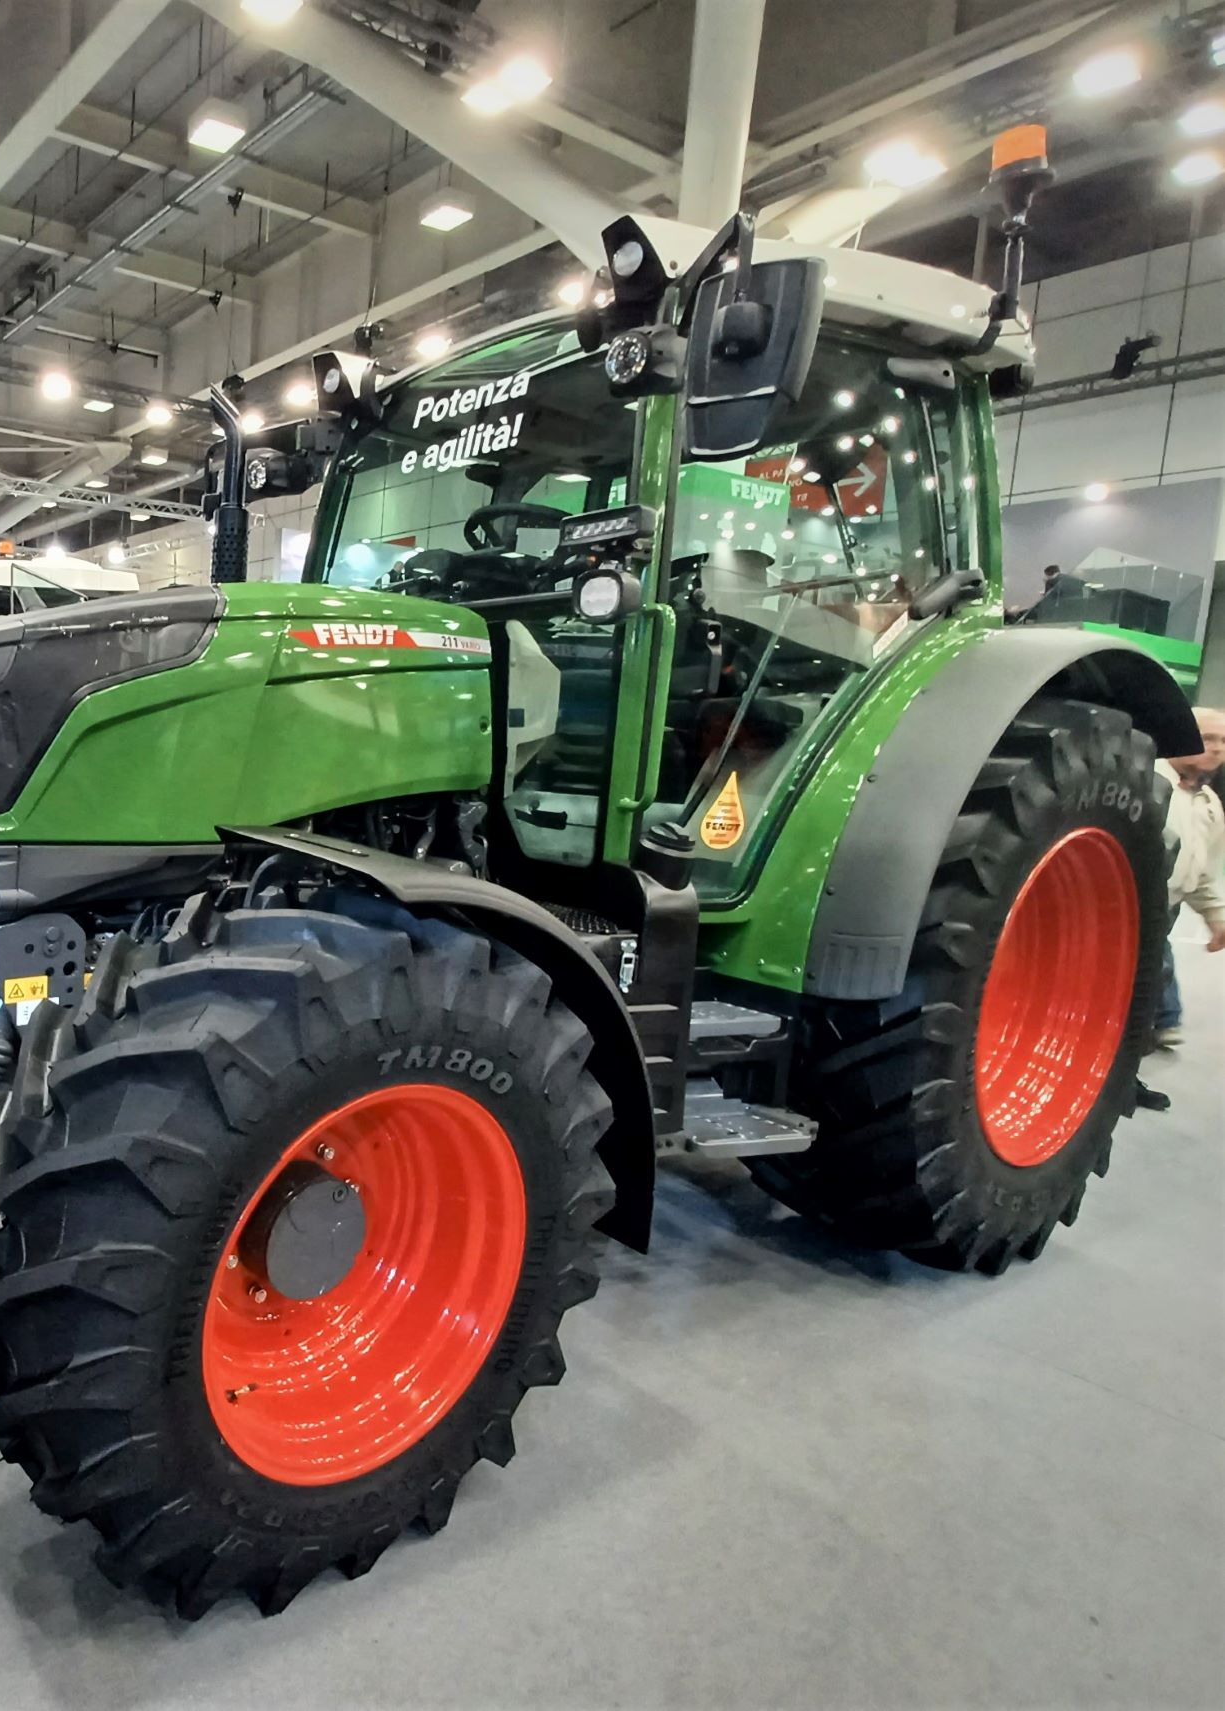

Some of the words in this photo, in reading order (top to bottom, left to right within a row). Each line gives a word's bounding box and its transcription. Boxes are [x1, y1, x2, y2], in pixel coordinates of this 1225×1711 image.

[412, 371, 531, 429] Potenza
[401, 450, 418, 474] e
[422, 413, 524, 473] agilità!
[730, 478, 787, 506] FENDT
[312, 623, 399, 646] FENDT
[441, 635, 459, 648] 211
